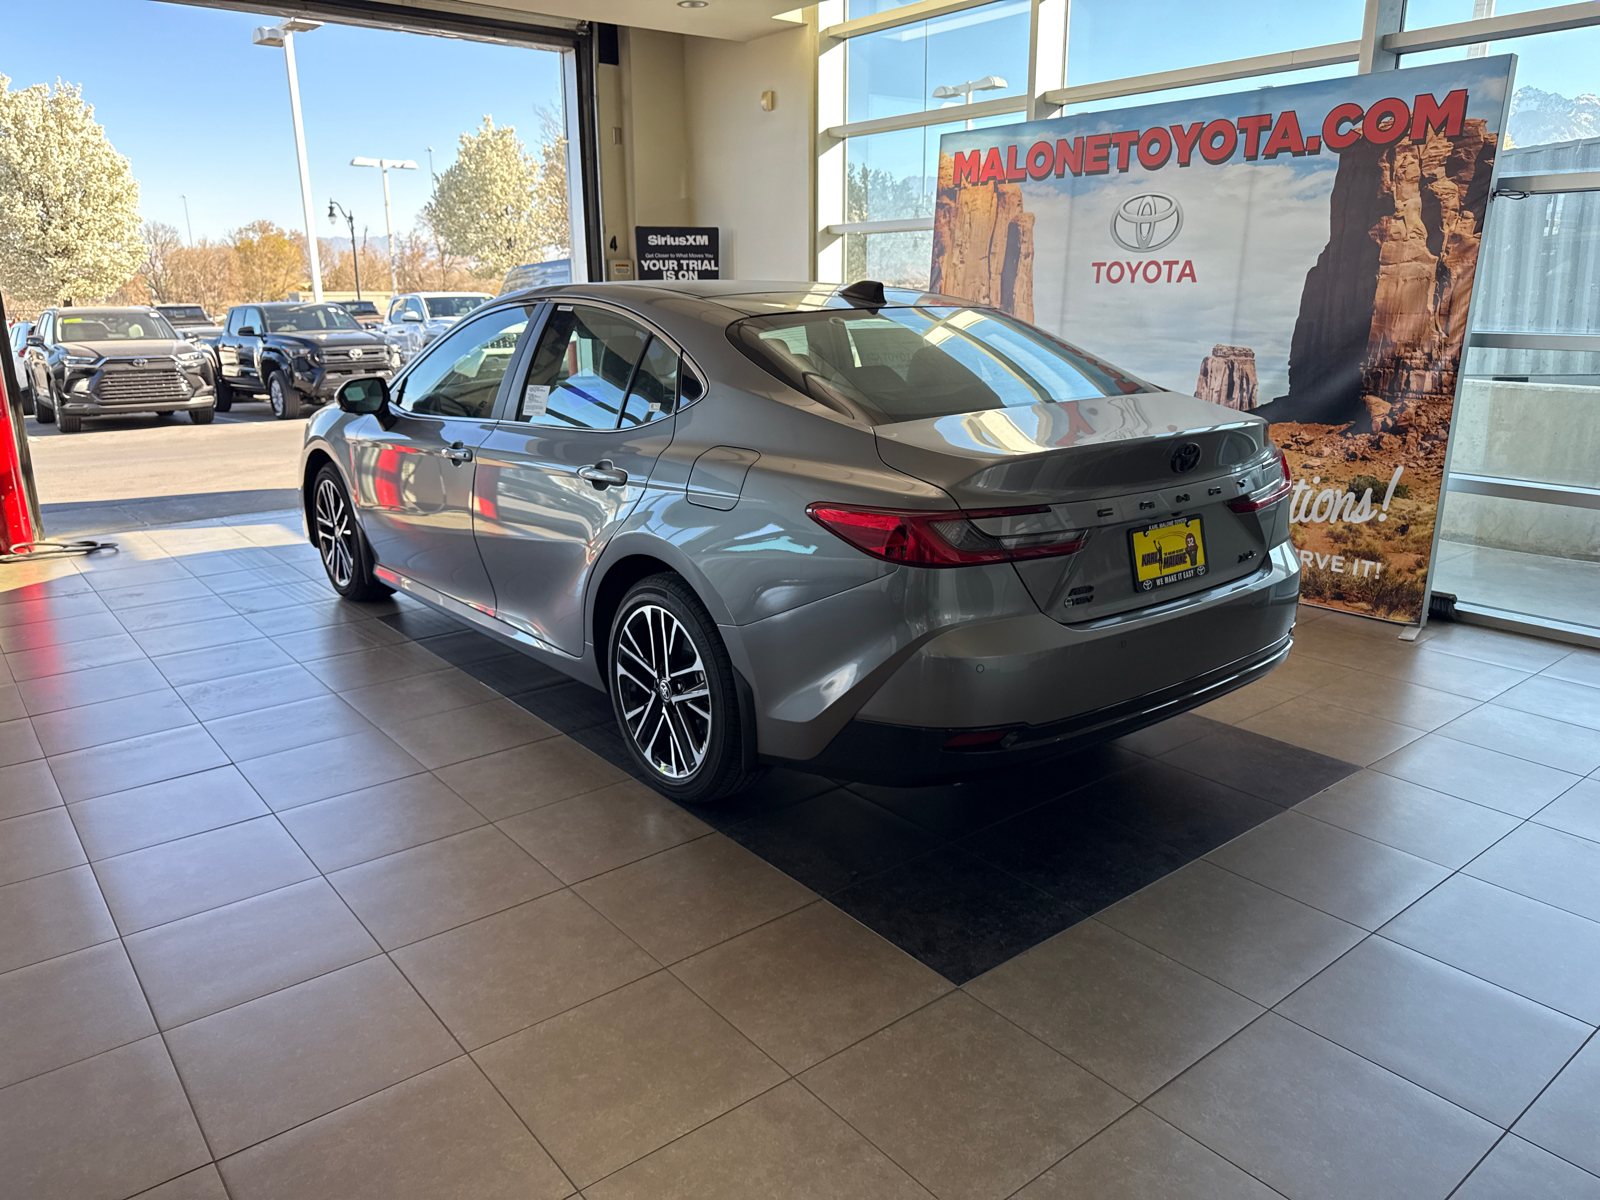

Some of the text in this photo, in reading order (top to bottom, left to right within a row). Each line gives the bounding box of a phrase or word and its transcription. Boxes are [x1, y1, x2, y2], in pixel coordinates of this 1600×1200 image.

[952, 89, 1469, 188] MALONETOYOTA.COM
[609, 235, 618, 251] 4
[647, 235, 709, 246] SiriusXM
[641, 259, 678, 271] YOUR
[680, 259, 719, 271] TRIAL
[1091, 260, 1197, 284] TOYOTA
[662, 270, 699, 280] IS ON
[1187, 537, 1195, 546] 32
[1141, 551, 1159, 567] KARL
[1163, 553, 1187, 569] MALONE
[1352, 557, 1382, 580] IT!
[1156, 569, 1194, 586] WE MAKE IT EASY
